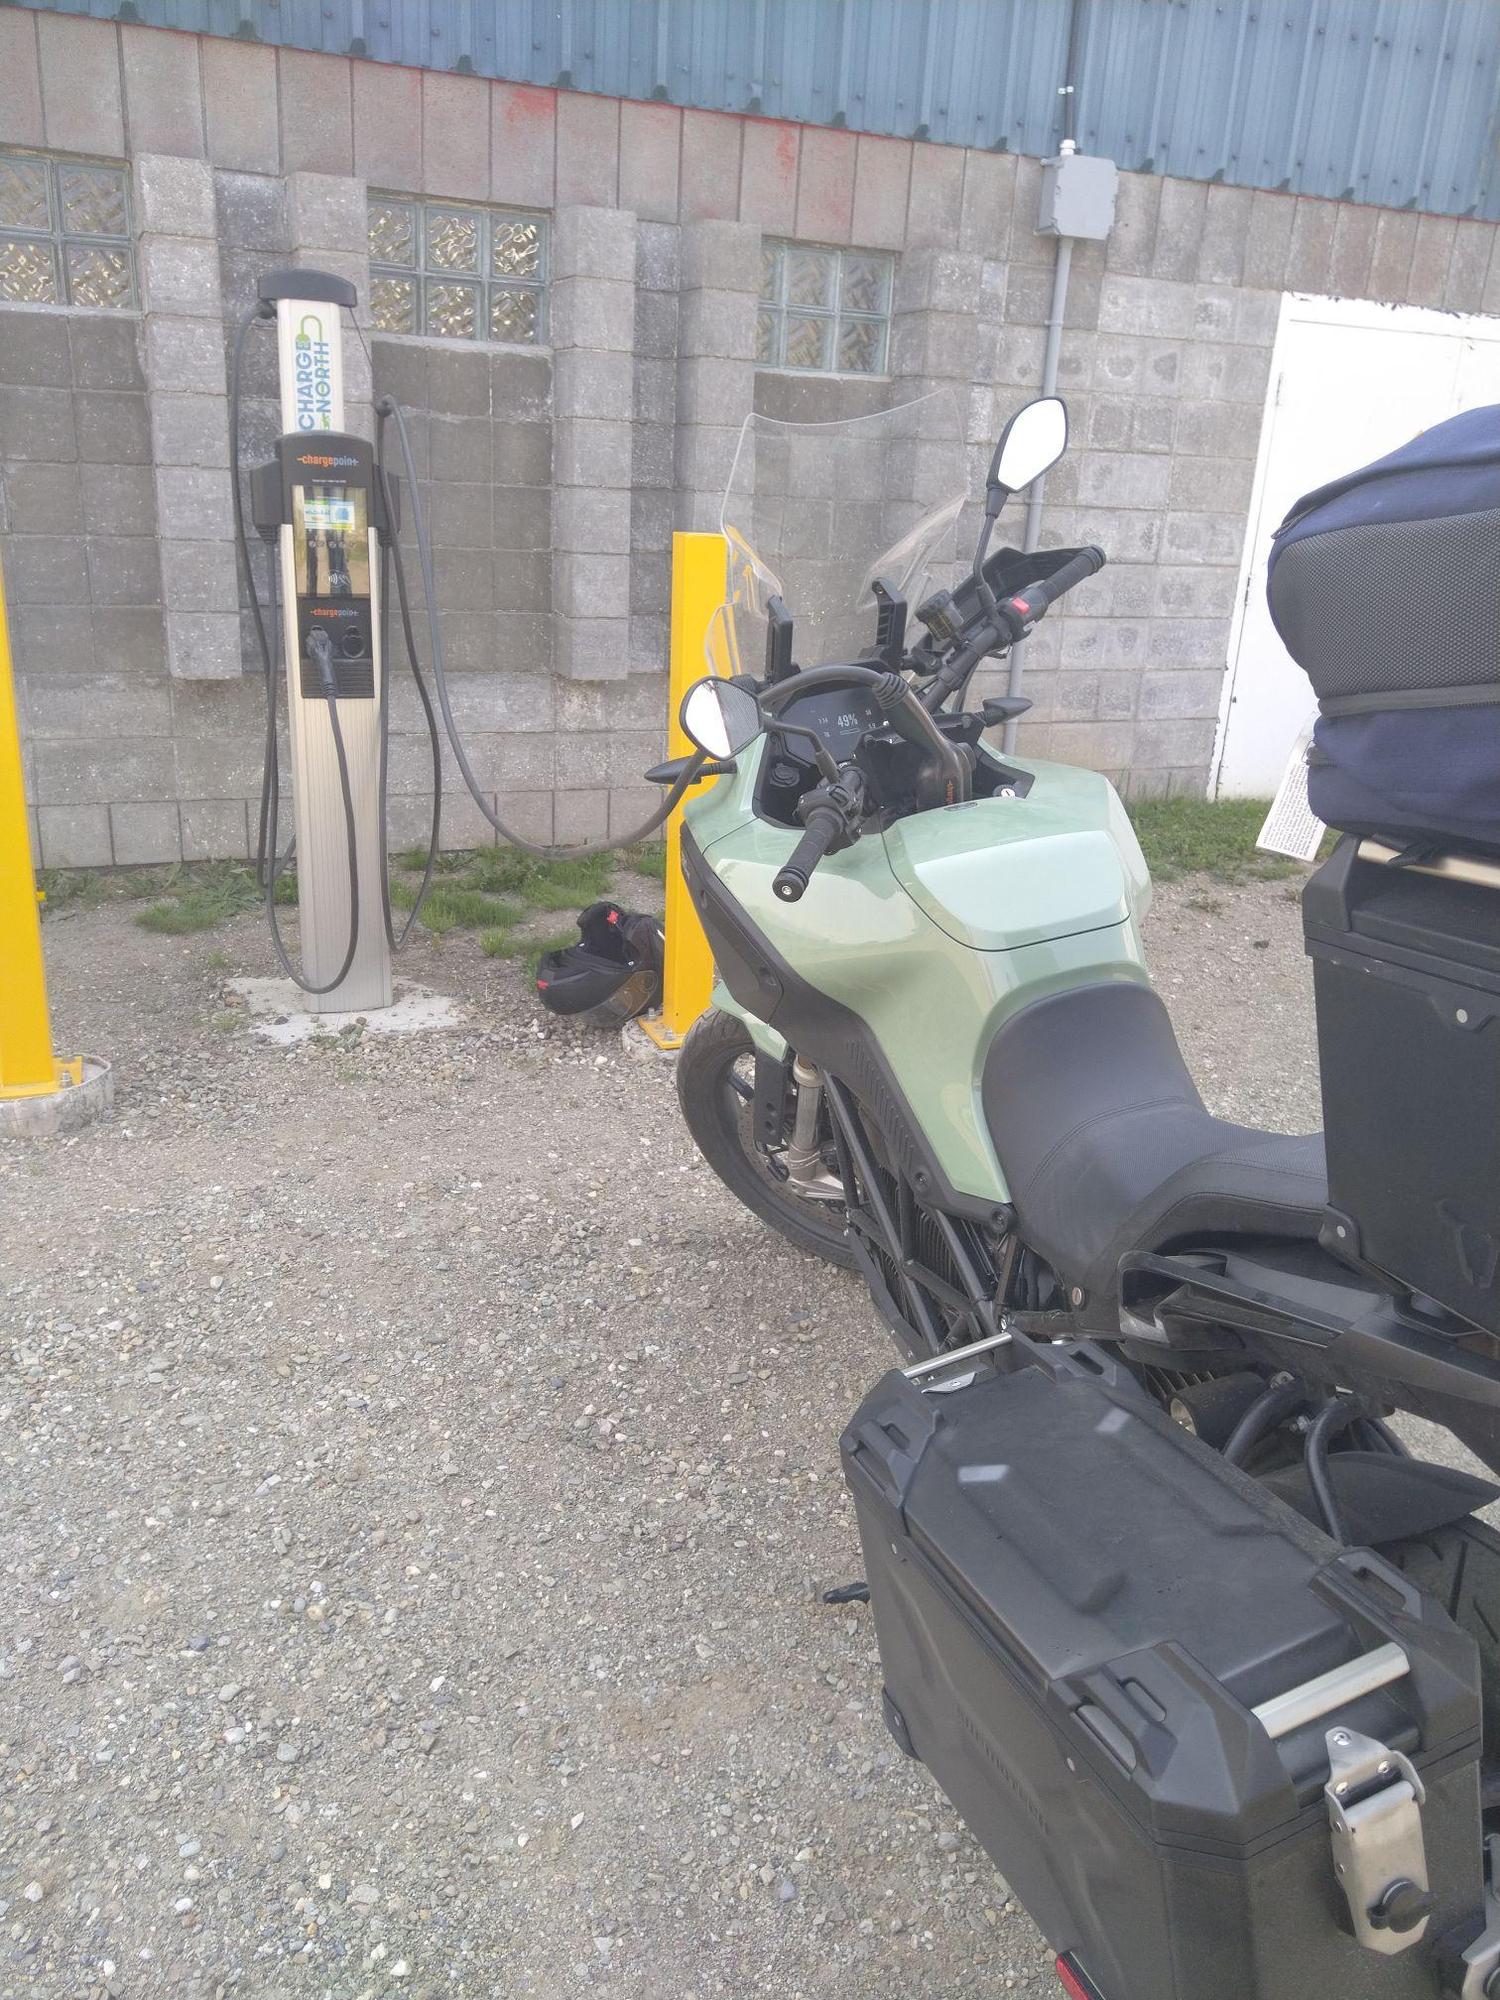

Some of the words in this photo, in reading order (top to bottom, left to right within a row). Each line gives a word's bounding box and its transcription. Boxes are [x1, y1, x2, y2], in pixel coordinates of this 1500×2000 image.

[295, 339, 315, 431] CHARGE
[314, 341, 331, 413] NORTH
[837, 713, 858, 727] 49%
